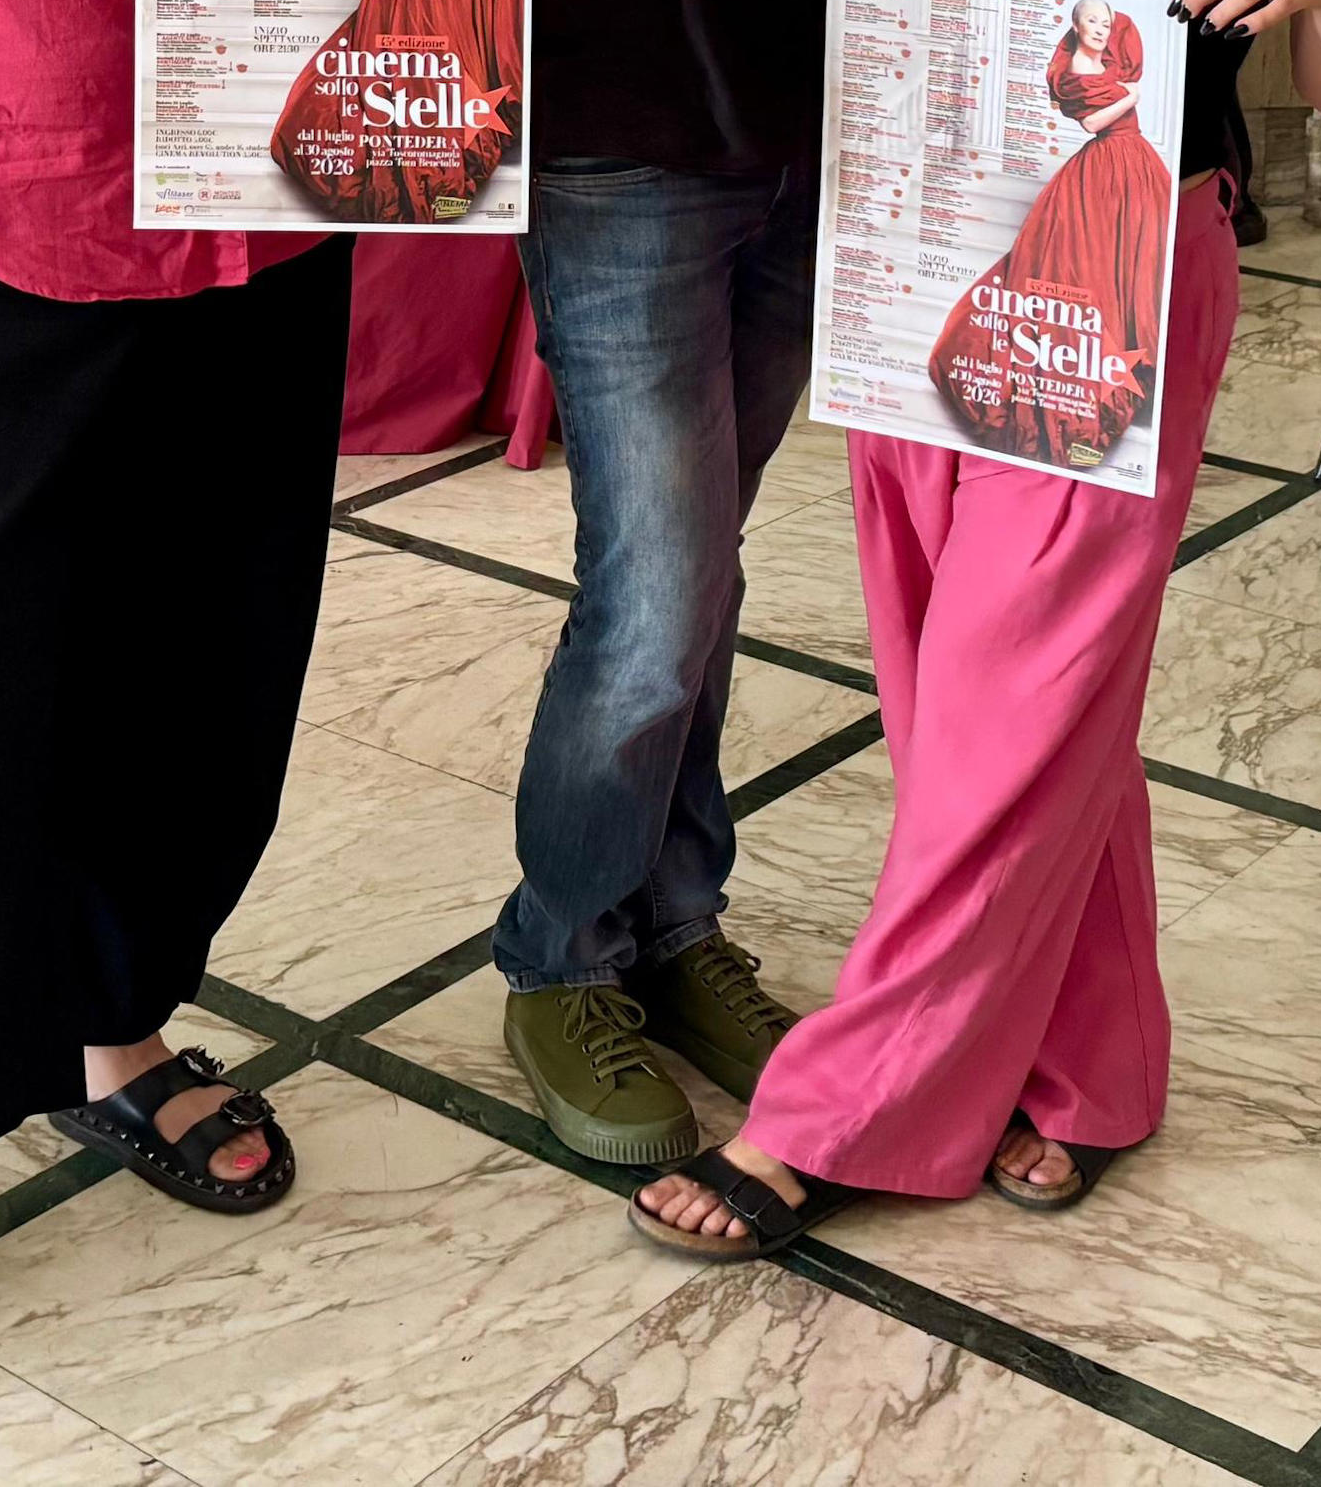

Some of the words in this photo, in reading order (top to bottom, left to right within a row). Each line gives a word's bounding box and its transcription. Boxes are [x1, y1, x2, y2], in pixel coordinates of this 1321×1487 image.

[398, 37, 445, 48] edizione
[316, 37, 462, 79] cinema
[342, 97, 359, 118] le
[362, 81, 491, 129] Stelle
[297, 129, 315, 141] dal
[317, 129, 322, 142] 1
[324, 129, 355, 145] luglio
[358, 134, 460, 149] PONTEDERA
[294, 143, 304, 156] al
[305, 144, 320, 156] 30
[321, 146, 355, 159] agosto
[310, 158, 354, 175] 2026
[971, 275, 1102, 334] cinema
[992, 330, 1008, 353] le
[952, 354, 968, 368] dal
[1010, 321, 1127, 386] Stelle
[962, 384, 1001, 407] 2026
[1006, 369, 1097, 402] PONTEDERA
